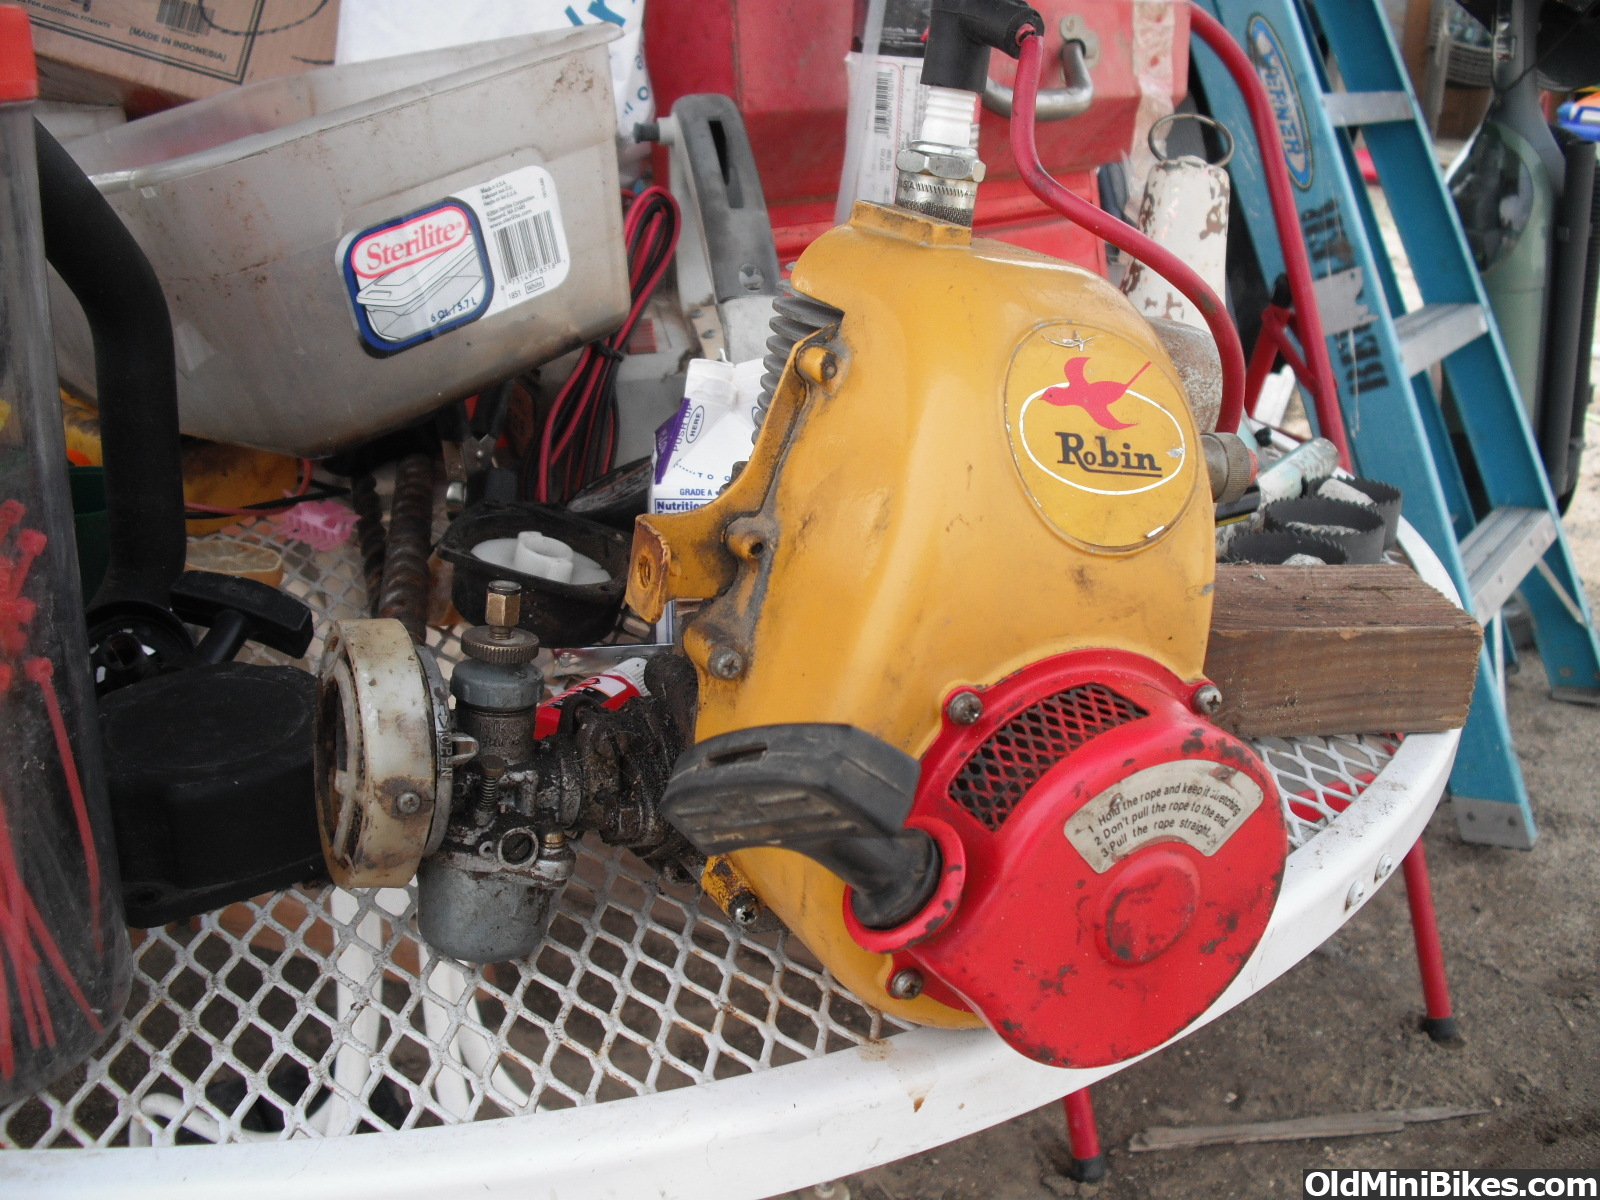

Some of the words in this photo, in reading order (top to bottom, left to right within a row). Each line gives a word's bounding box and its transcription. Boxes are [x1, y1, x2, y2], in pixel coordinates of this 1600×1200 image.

[41, 4, 79, 20] ADDITIONAL
[80, 15, 111, 29] FITMENTS
[129, 26, 161, 43] (MADE
[161, 36, 172, 46] IN
[173, 40, 228, 63] INDONESIA)
[366, 222, 456, 272] Sterilite
[508, 289, 522, 300] 1851
[526, 281, 543, 291] White
[430, 312, 437, 323] 6
[437, 308, 452, 321] Qt.
[457, 298, 470, 312] 5.7
[470, 296, 477, 306] L
[673, 423, 688, 452] PUSH
[685, 404, 693, 419] UP
[690, 412, 702, 437] HERE
[1055, 431, 1162, 477] Robin
[698, 472, 714, 480] TO
[656, 501, 707, 511] Nutritio
[679, 488, 706, 497] GRADE
[707, 488, 713, 497] A
[1097, 803, 1121, 826] Hold
[1122, 797, 1138, 812] the
[1140, 788, 1162, 804] rope
[1163, 782, 1182, 796] and
[1181, 782, 1203, 796] keep
[1202, 785, 1211, 797] it
[1102, 816, 1129, 839] Don't
[1131, 805, 1149, 824] pull
[1151, 801, 1167, 814] the
[1168, 801, 1190, 813] rope
[1190, 801, 1201, 813] to
[1201, 804, 1215, 818] the
[1109, 833, 1128, 852] Pull
[1132, 825, 1148, 838] the
[1153, 818, 1175, 830] rope
